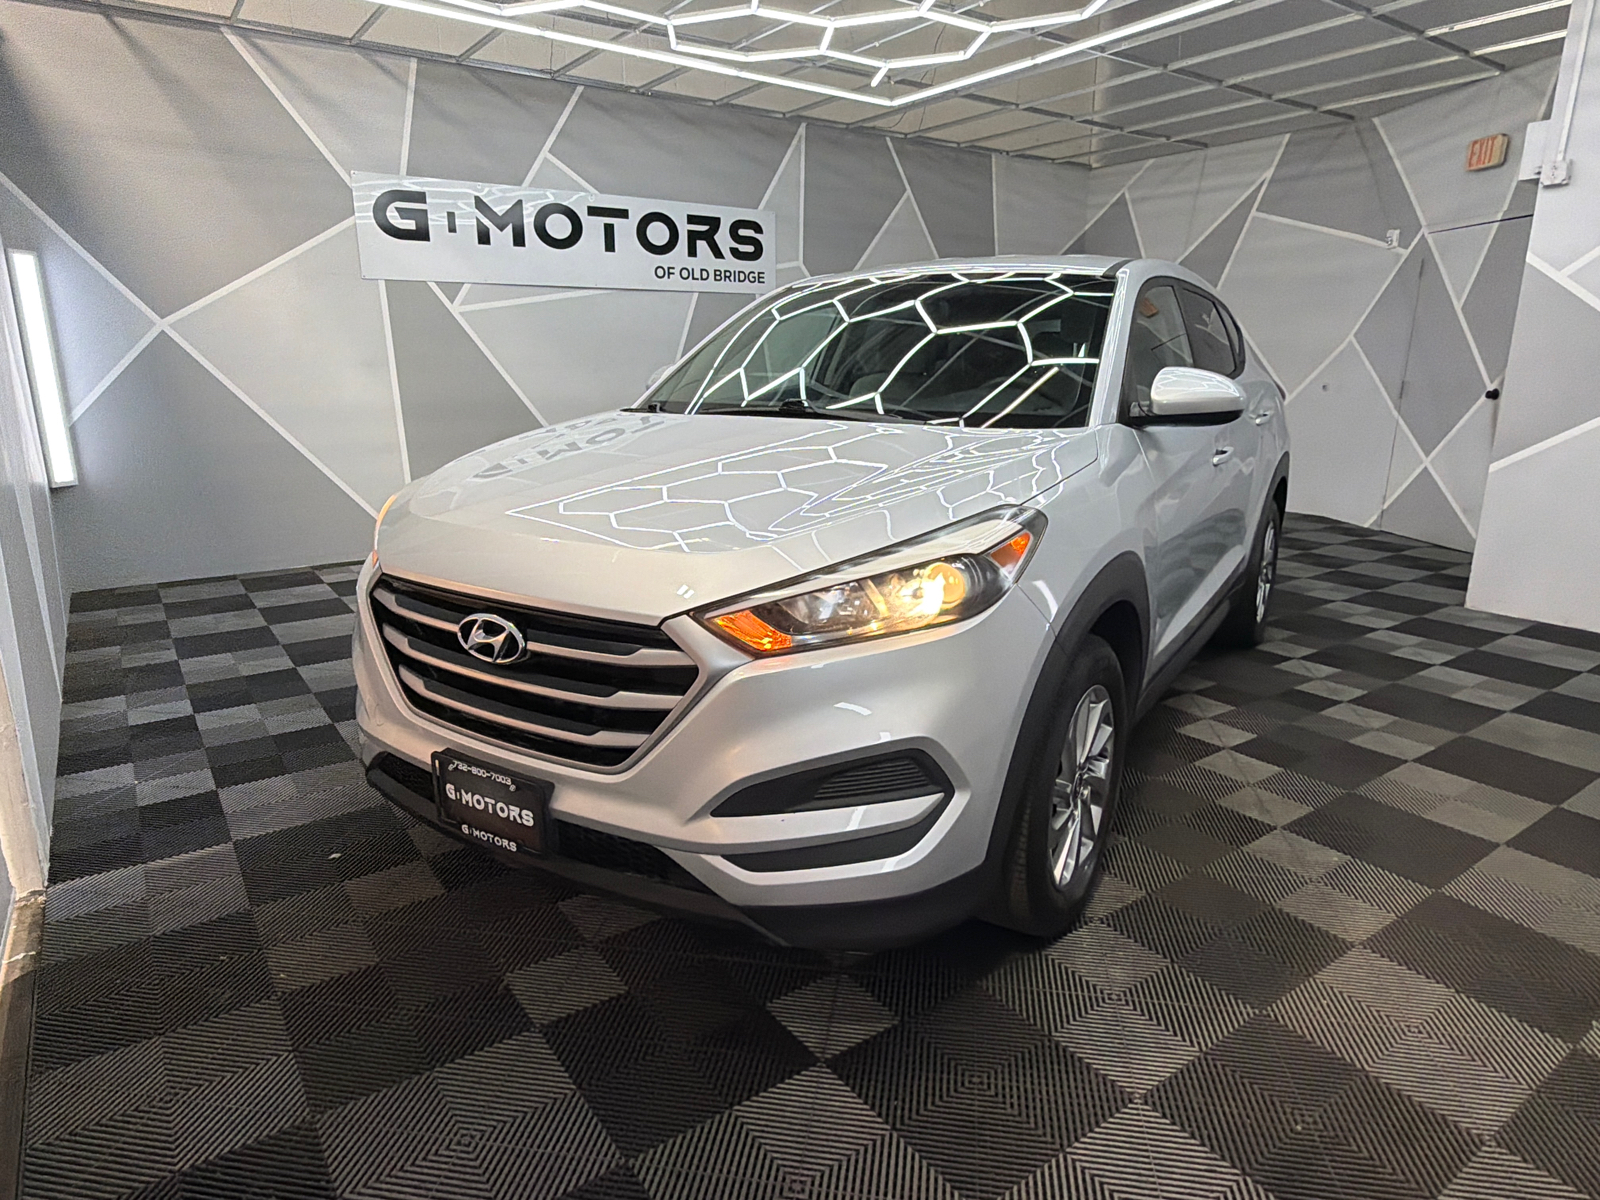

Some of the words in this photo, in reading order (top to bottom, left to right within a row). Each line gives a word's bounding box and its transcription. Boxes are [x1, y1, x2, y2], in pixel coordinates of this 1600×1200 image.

[654, 265, 675, 279] OF
[679, 267, 710, 281] OLD
[713, 269, 766, 284] BRIDGE
